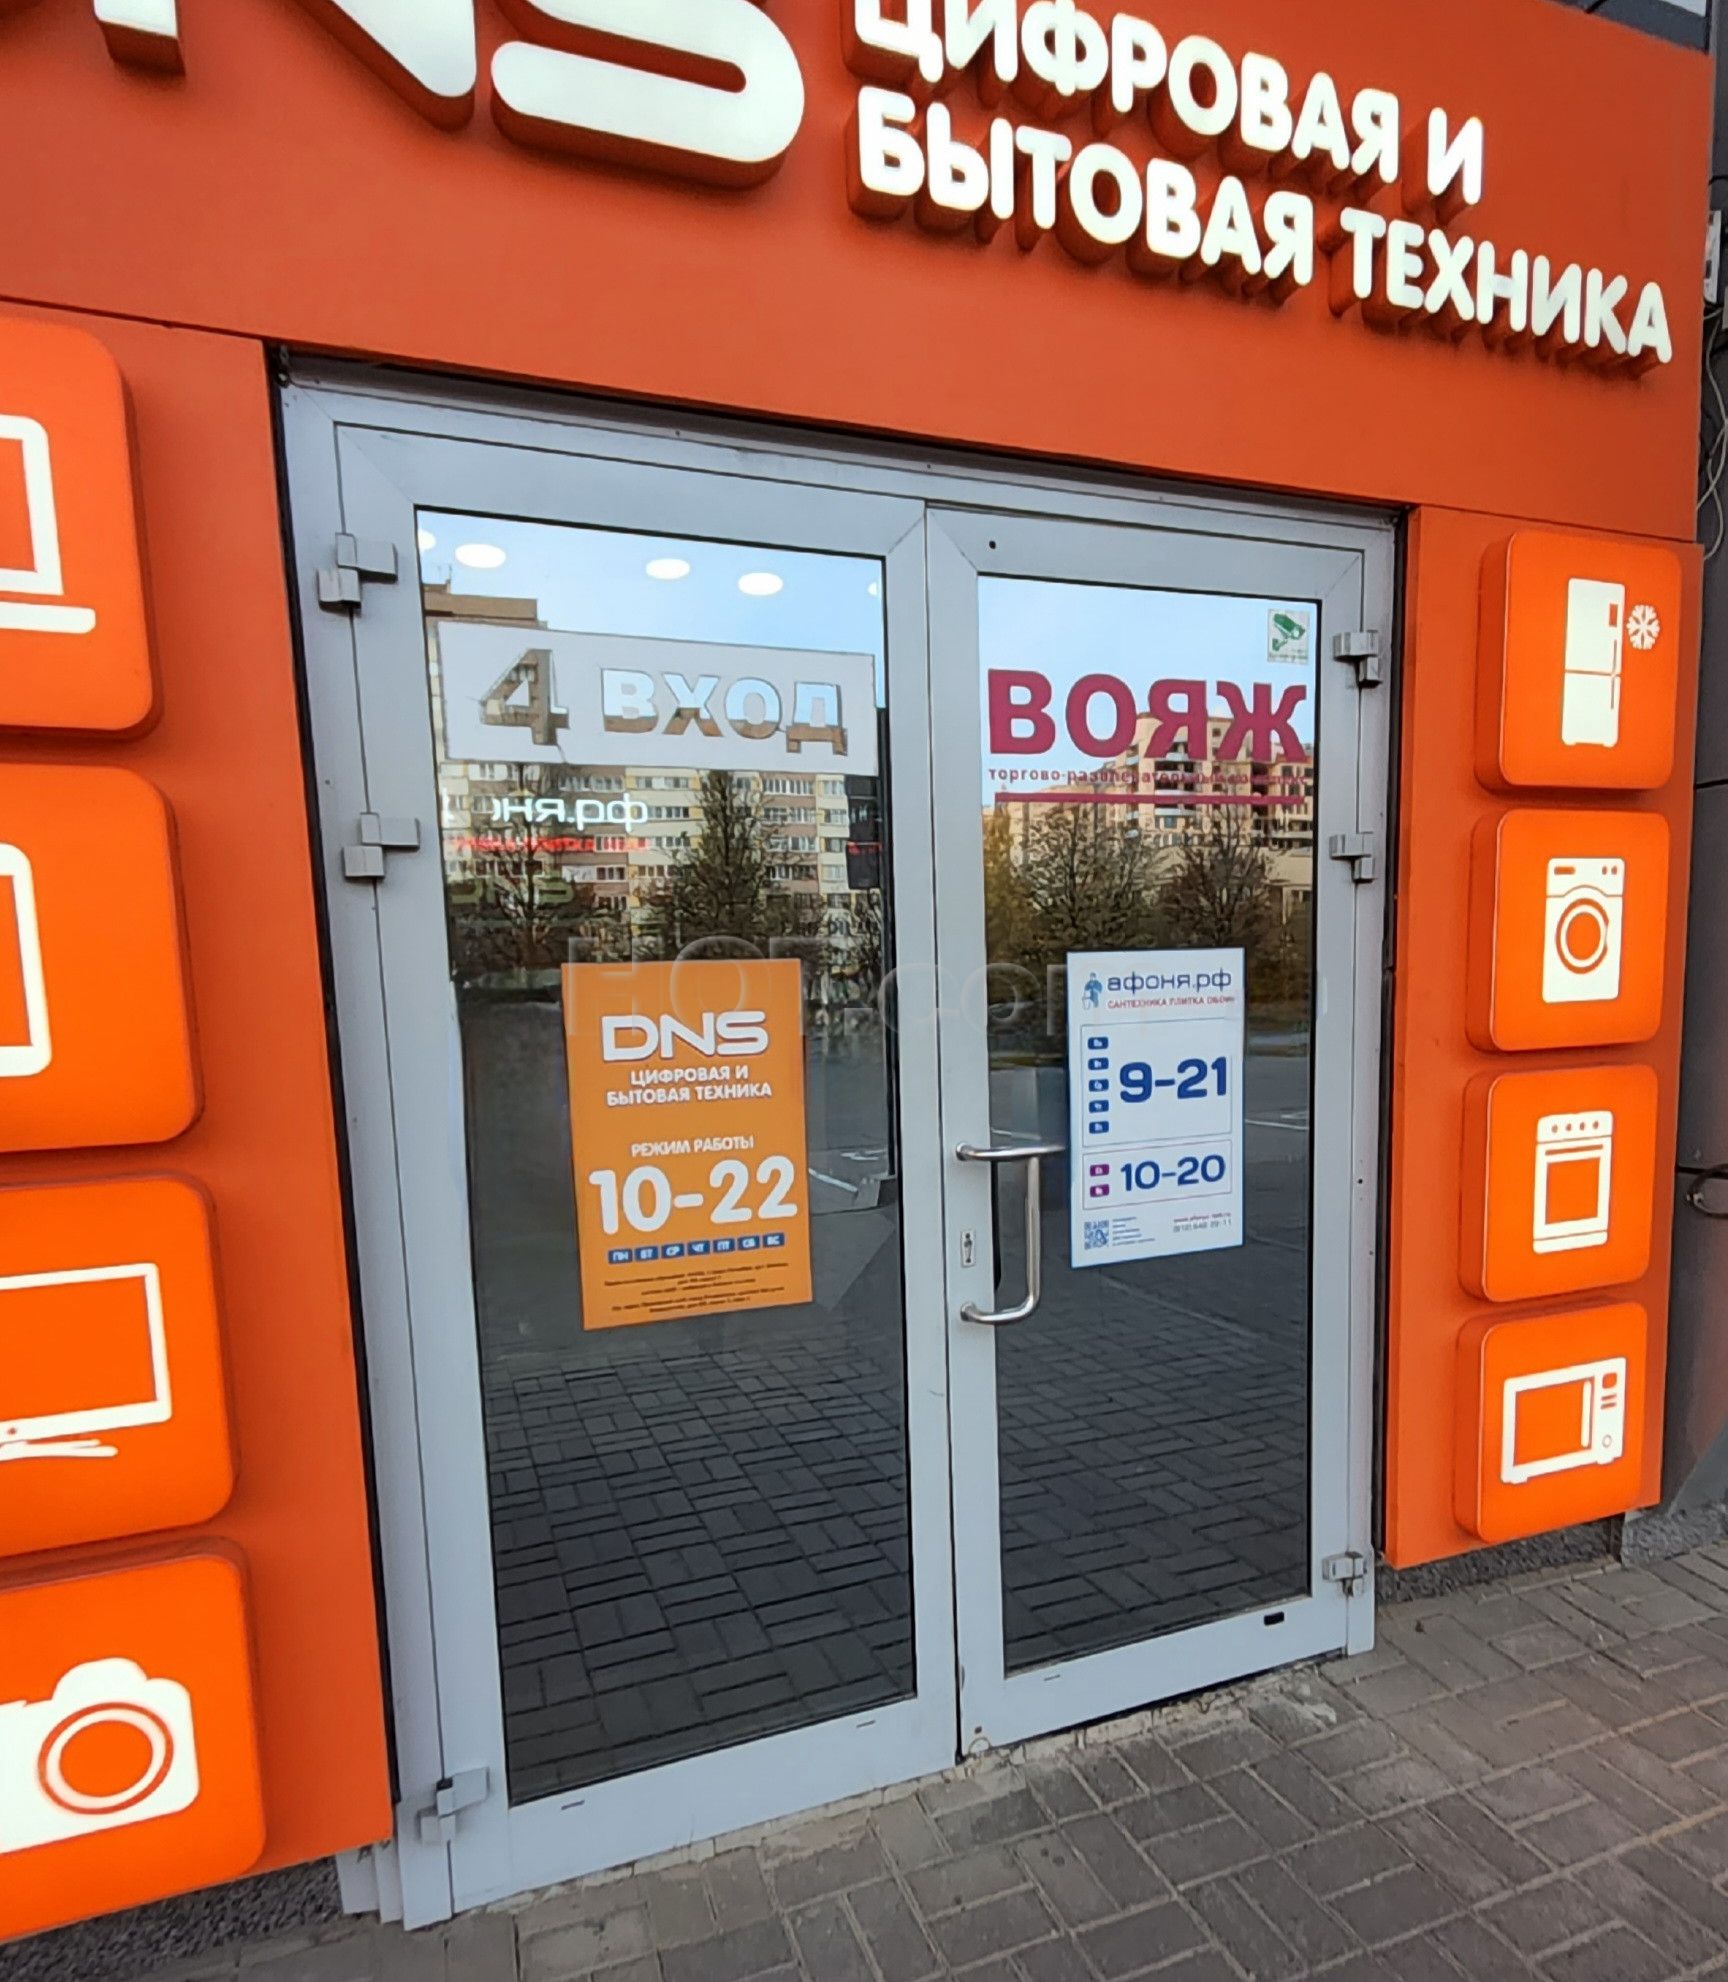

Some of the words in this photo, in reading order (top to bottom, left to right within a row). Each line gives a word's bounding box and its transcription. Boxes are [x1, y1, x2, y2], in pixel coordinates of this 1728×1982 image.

[854, 0, 1400, 184] ЦИФРОВАЯ
[1427, 107, 1484, 206] И
[857, 85, 1315, 286] БЫТОВАЯ
[1340, 206, 1673, 364] ТЕХНИКА
[479, 648, 569, 746] 4
[988, 668, 1309, 763] ВОЯЖ
[1107, 967, 1232, 995] афоня.рф
[601, 1009, 769, 1062] DNS
[606, 1086, 691, 1107] БЫТОВАЯ
[694, 1082, 773, 1101] ТЕХНИКА
[630, 1065, 731, 1087] ЦИФРОВАЯ
[735, 1065, 749, 1079] И
[631, 1139, 691, 1157] РЕЖИМ
[693, 1135, 754, 1153] РАБОТЫ
[666, 1246, 680, 1256] СР
